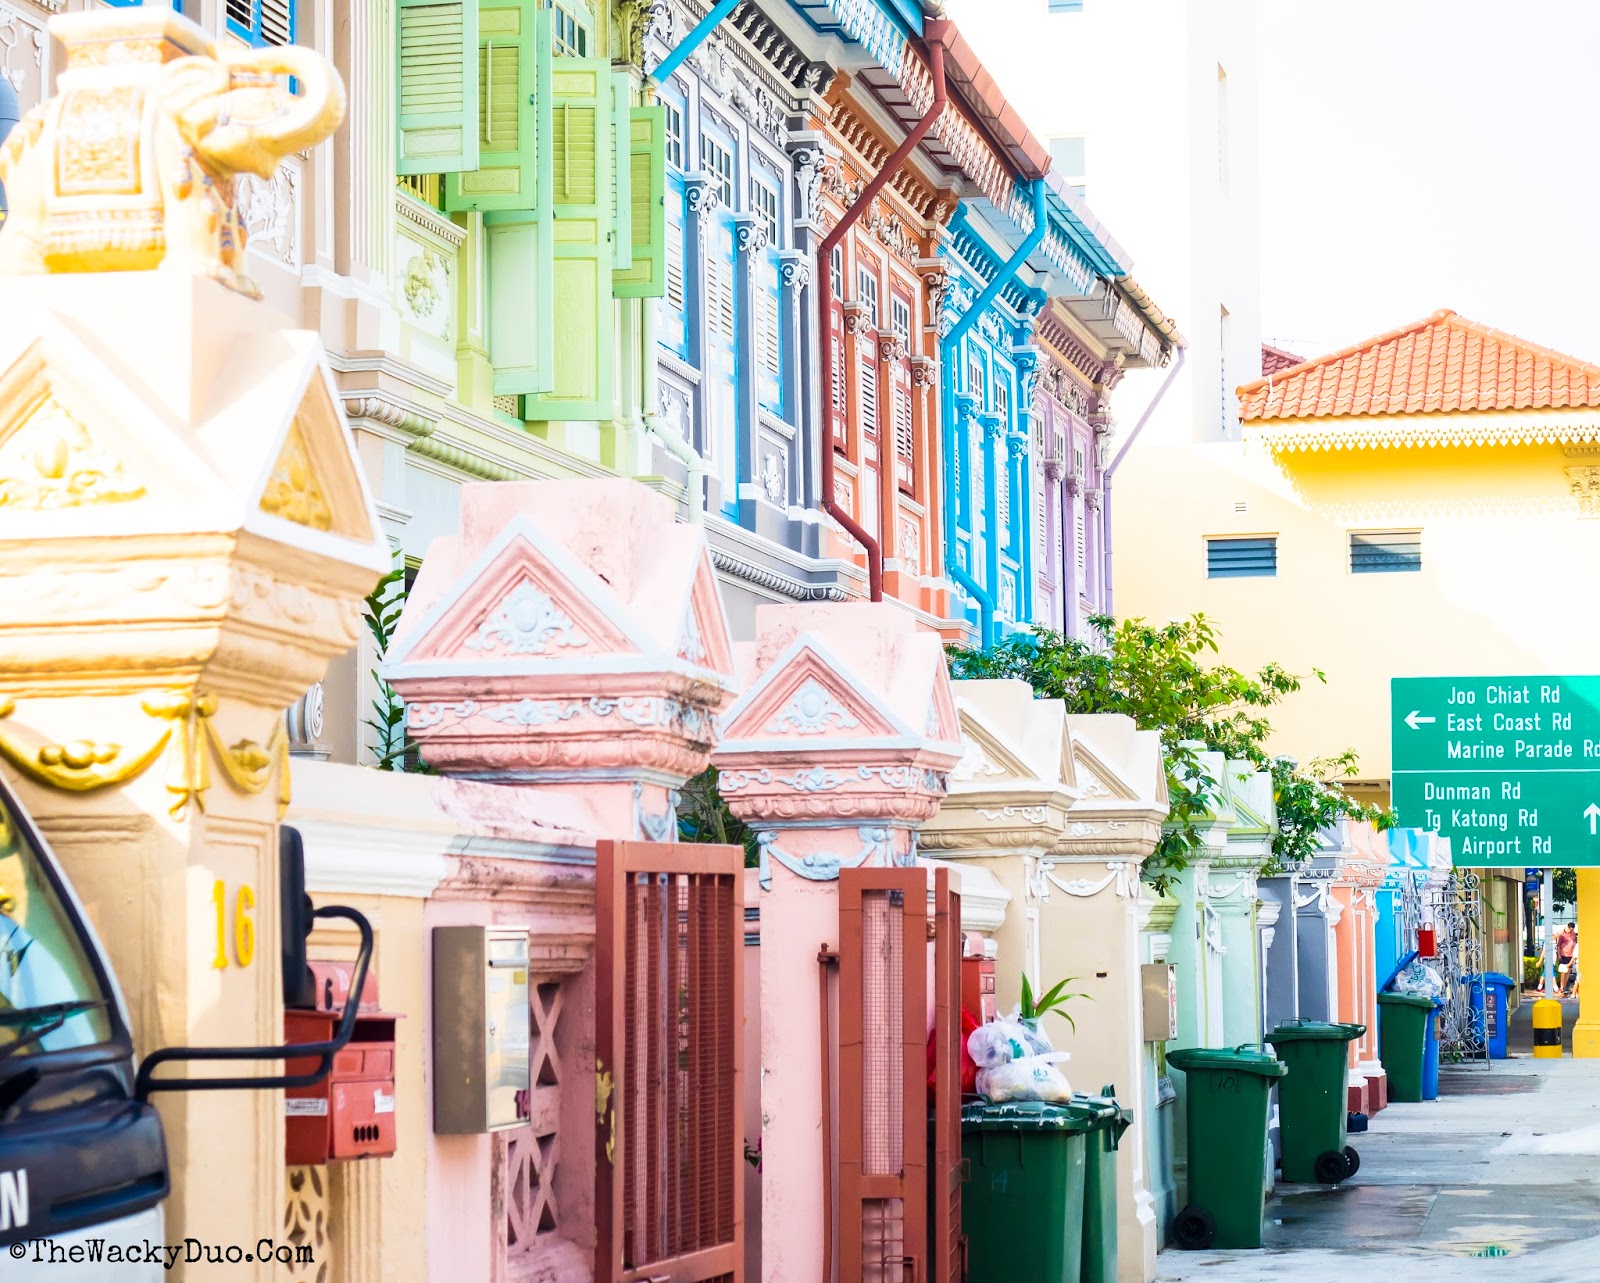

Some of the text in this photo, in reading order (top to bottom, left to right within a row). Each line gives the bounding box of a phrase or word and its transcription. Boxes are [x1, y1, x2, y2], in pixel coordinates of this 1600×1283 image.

[1447, 685, 1561, 705] Joo Chiat Rd
[1447, 712, 1572, 732] East Coast Rd
[1447, 739, 1600, 759] Marine Parade Rd
[1424, 781, 1521, 801] Dunman Rd
[1425, 808, 1538, 831] Tg Katong Rd
[1461, 835, 1552, 859] Airport Rd
[212, 880, 255, 968] 16
